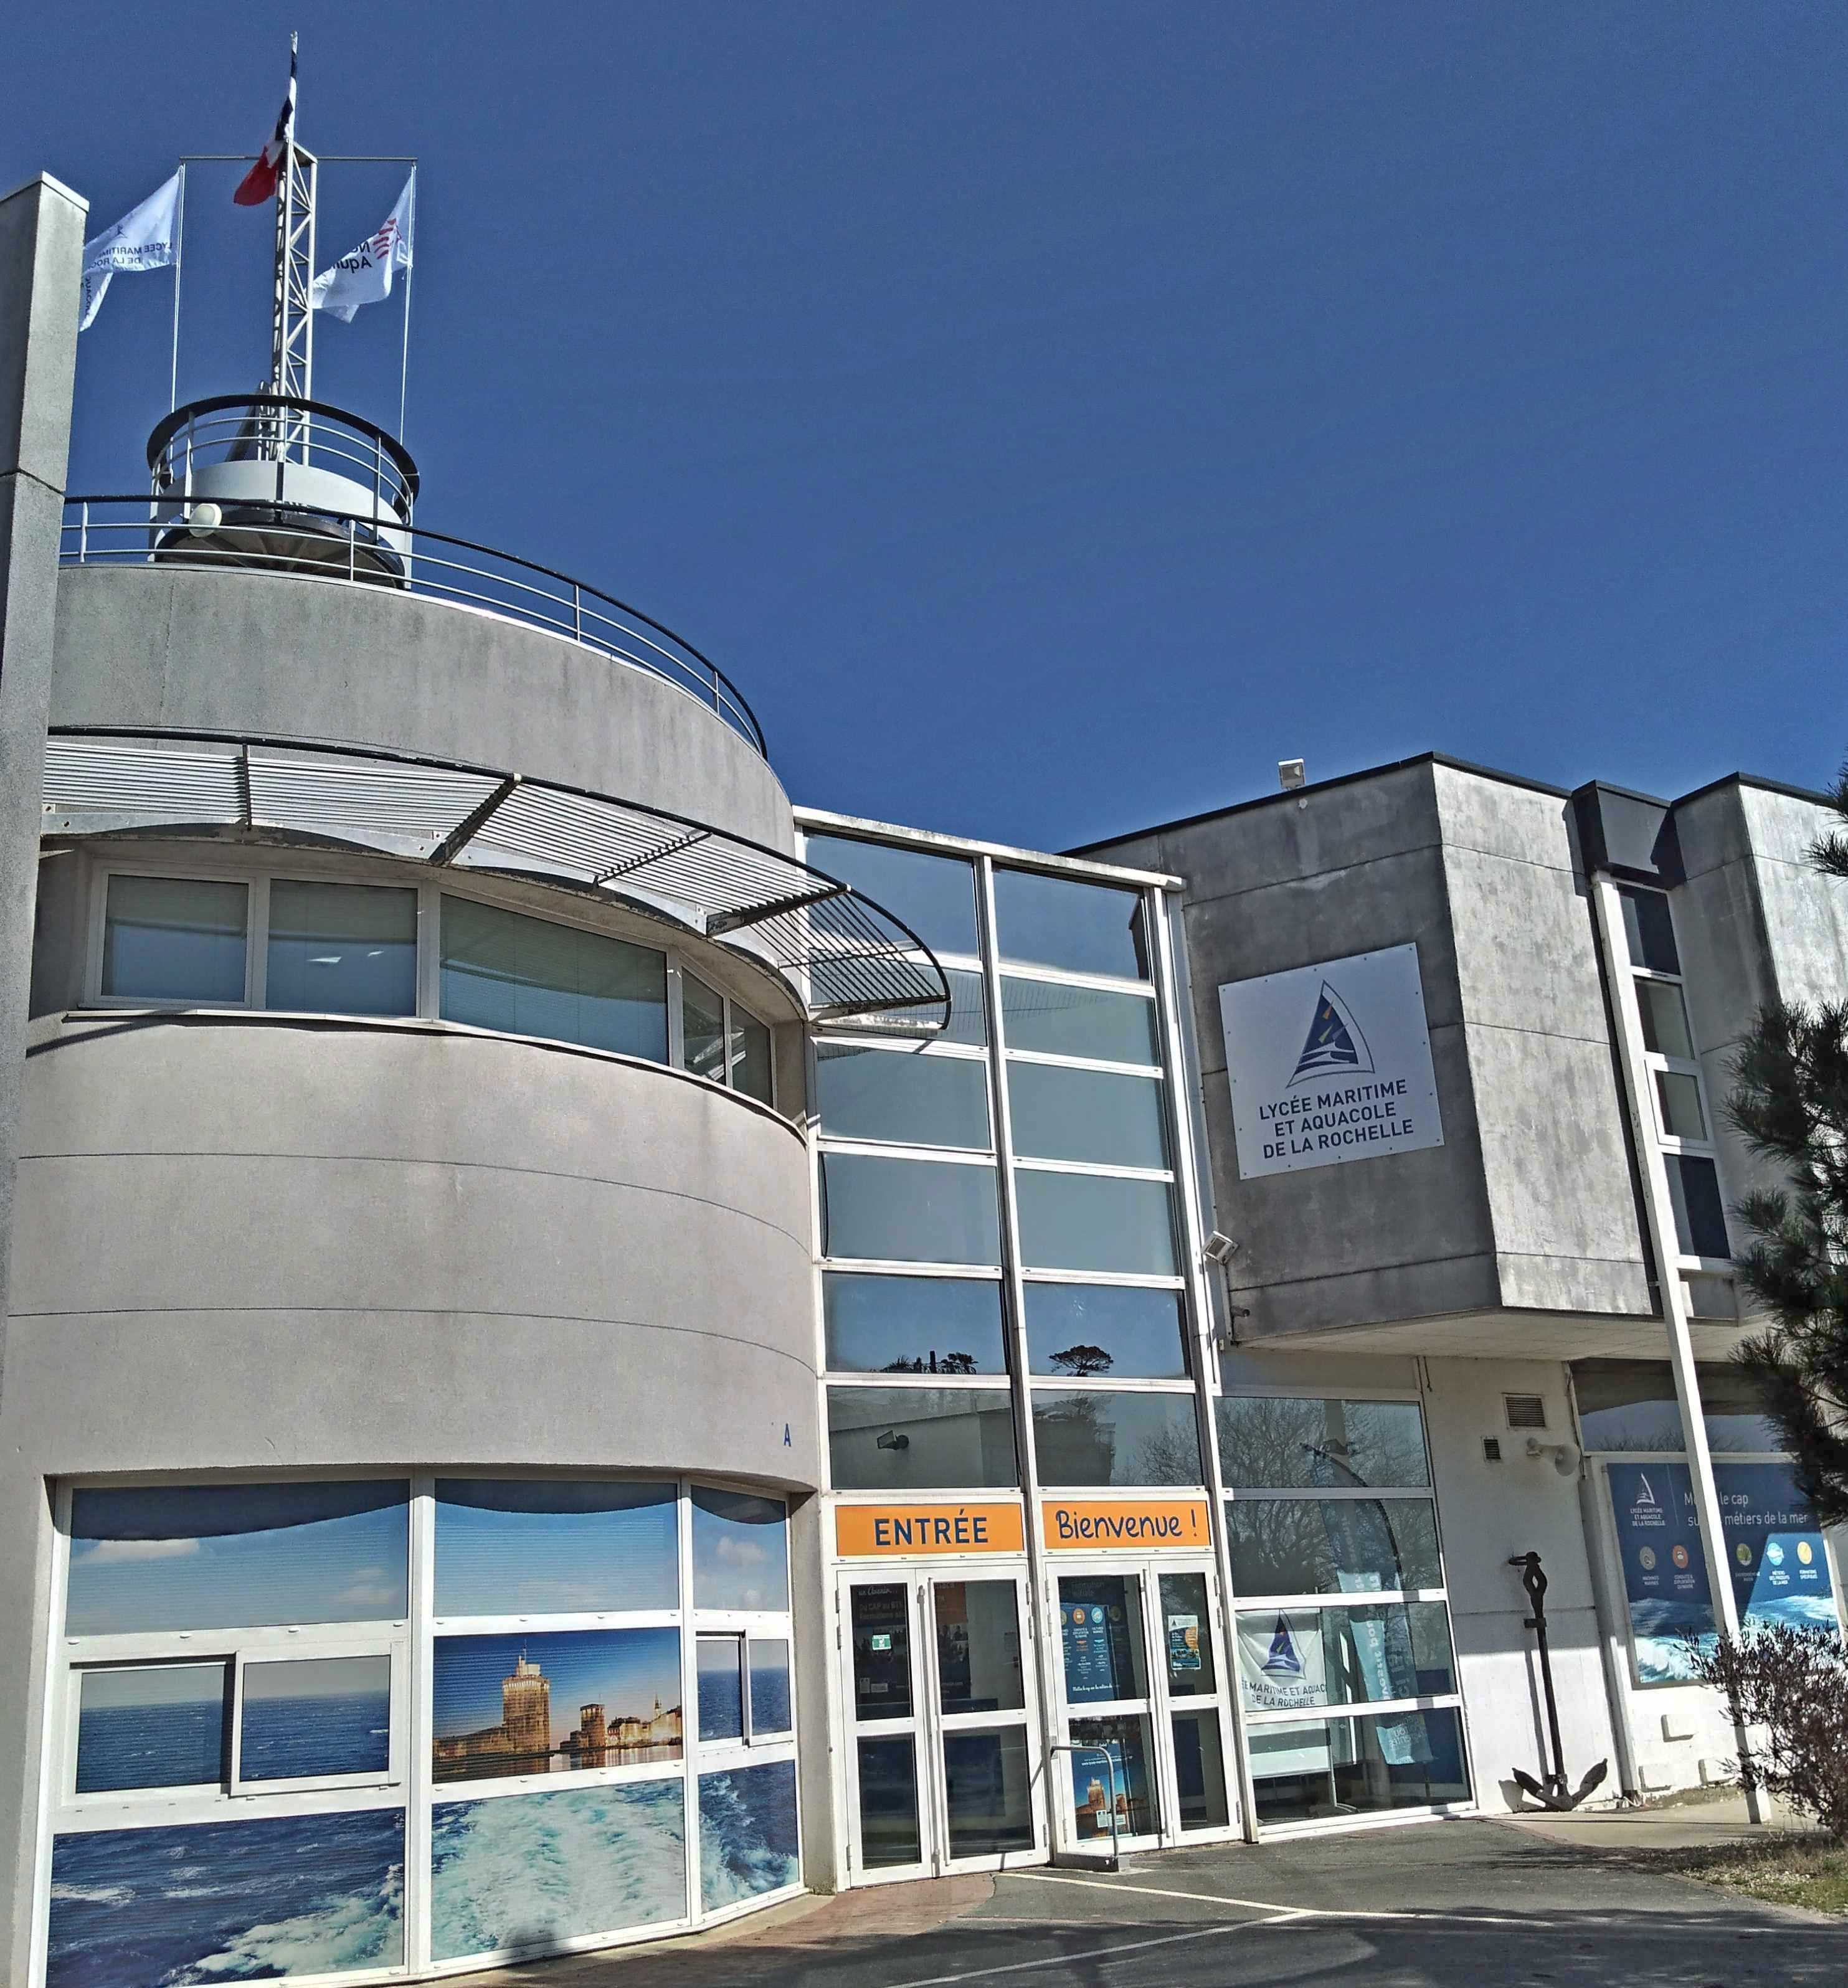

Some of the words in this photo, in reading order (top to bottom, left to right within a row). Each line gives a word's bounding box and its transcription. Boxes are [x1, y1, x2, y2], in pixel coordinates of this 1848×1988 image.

[1259, 1095, 1312, 1120] LYCÉE
[1317, 1079, 1407, 1109] MARITIME
[1274, 1119, 1295, 1137] ET
[1301, 1102, 1396, 1133] AQUACOLE
[1263, 1142, 1286, 1159] DE
[1291, 1138, 1314, 1154] LA
[1319, 1119, 1414, 1150] ROCHELLE
[784, 1422, 792, 1447] A
[1720, 1492, 1729, 1505] le
[1732, 1495, 1749, 1507] cap
[874, 1508, 988, 1546] ENTRÉE
[1056, 1509, 1183, 1540] Bienvenue
[1191, 1508, 1197, 1537] !
[1688, 1517, 1700, 1527] su
[1725, 1512, 1762, 1525] métiers
[1764, 1511, 1776, 1525] de
[1778, 1511, 1787, 1524] la
[1789, 1514, 1808, 1523] mer
[1249, 1682, 1289, 1696] MARITIME
[1291, 1687, 1300, 1696] ET
[1252, 1695, 1262, 1704] DE
[1264, 1696, 1275, 1705] LA
[1277, 1697, 1315, 1707] ROCHELLE
